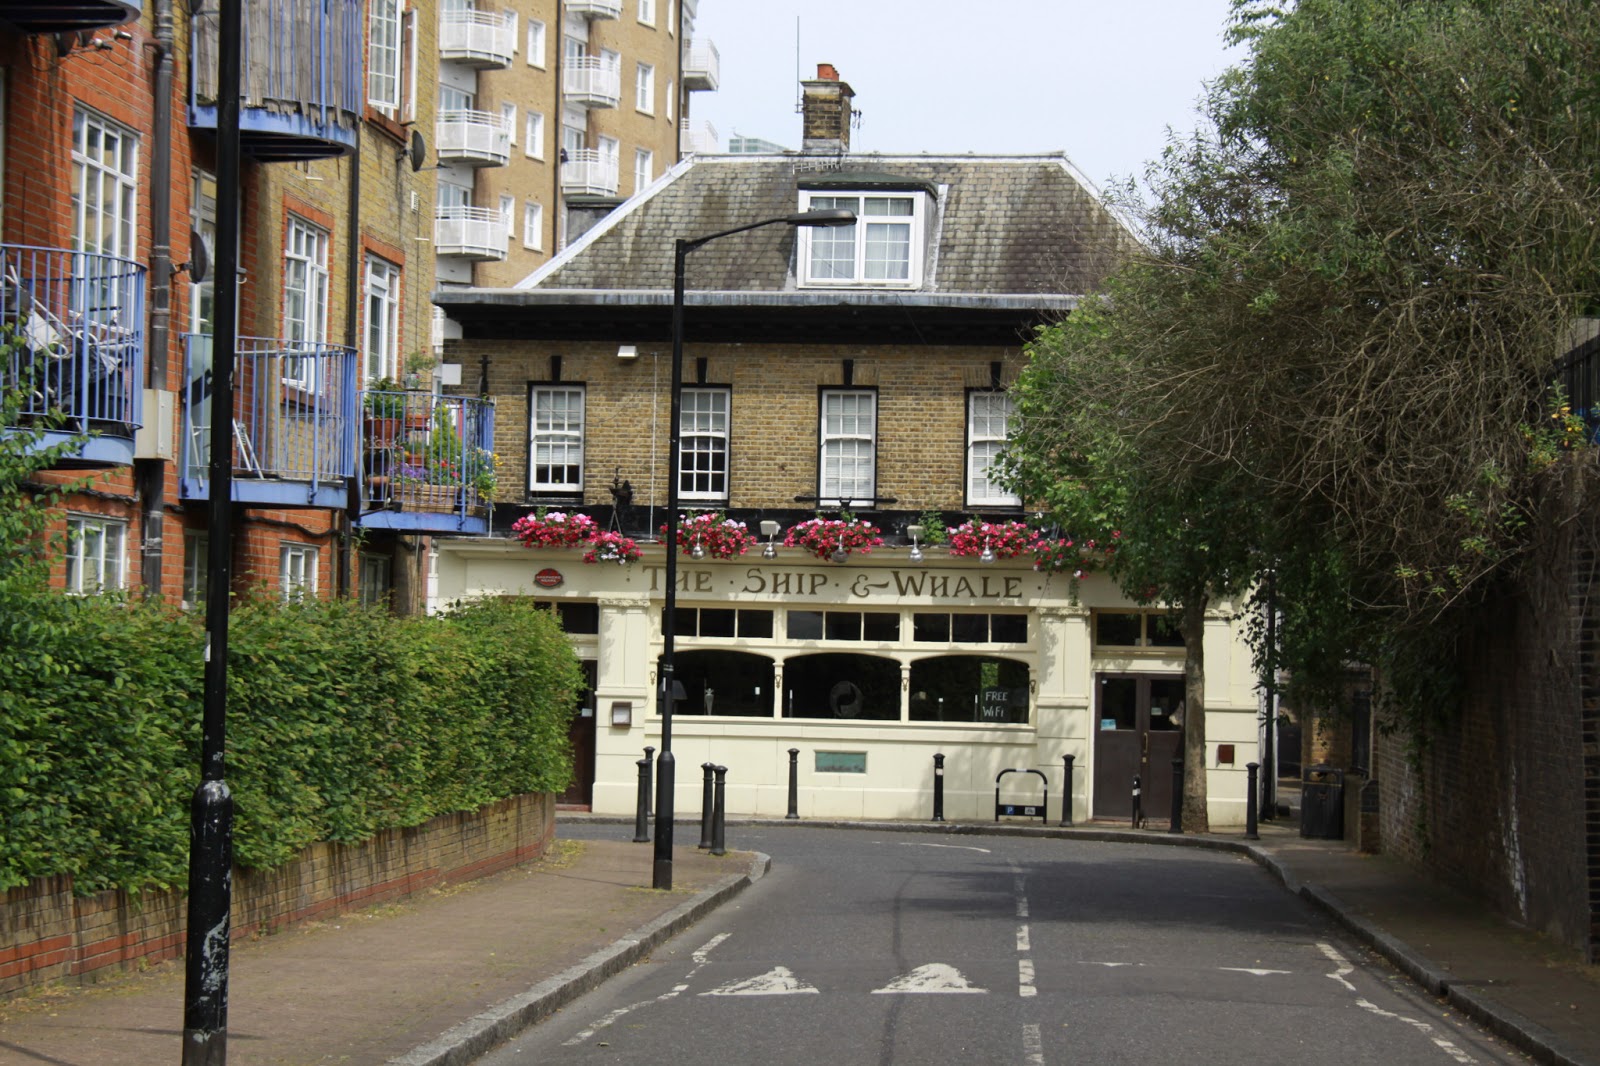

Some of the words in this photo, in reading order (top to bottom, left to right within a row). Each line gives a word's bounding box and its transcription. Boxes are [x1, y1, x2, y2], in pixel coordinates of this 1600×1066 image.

[742, 568, 828, 595] SHIP
[890, 570, 1022, 598] WHALE
[985, 691, 1008, 701] FREE
